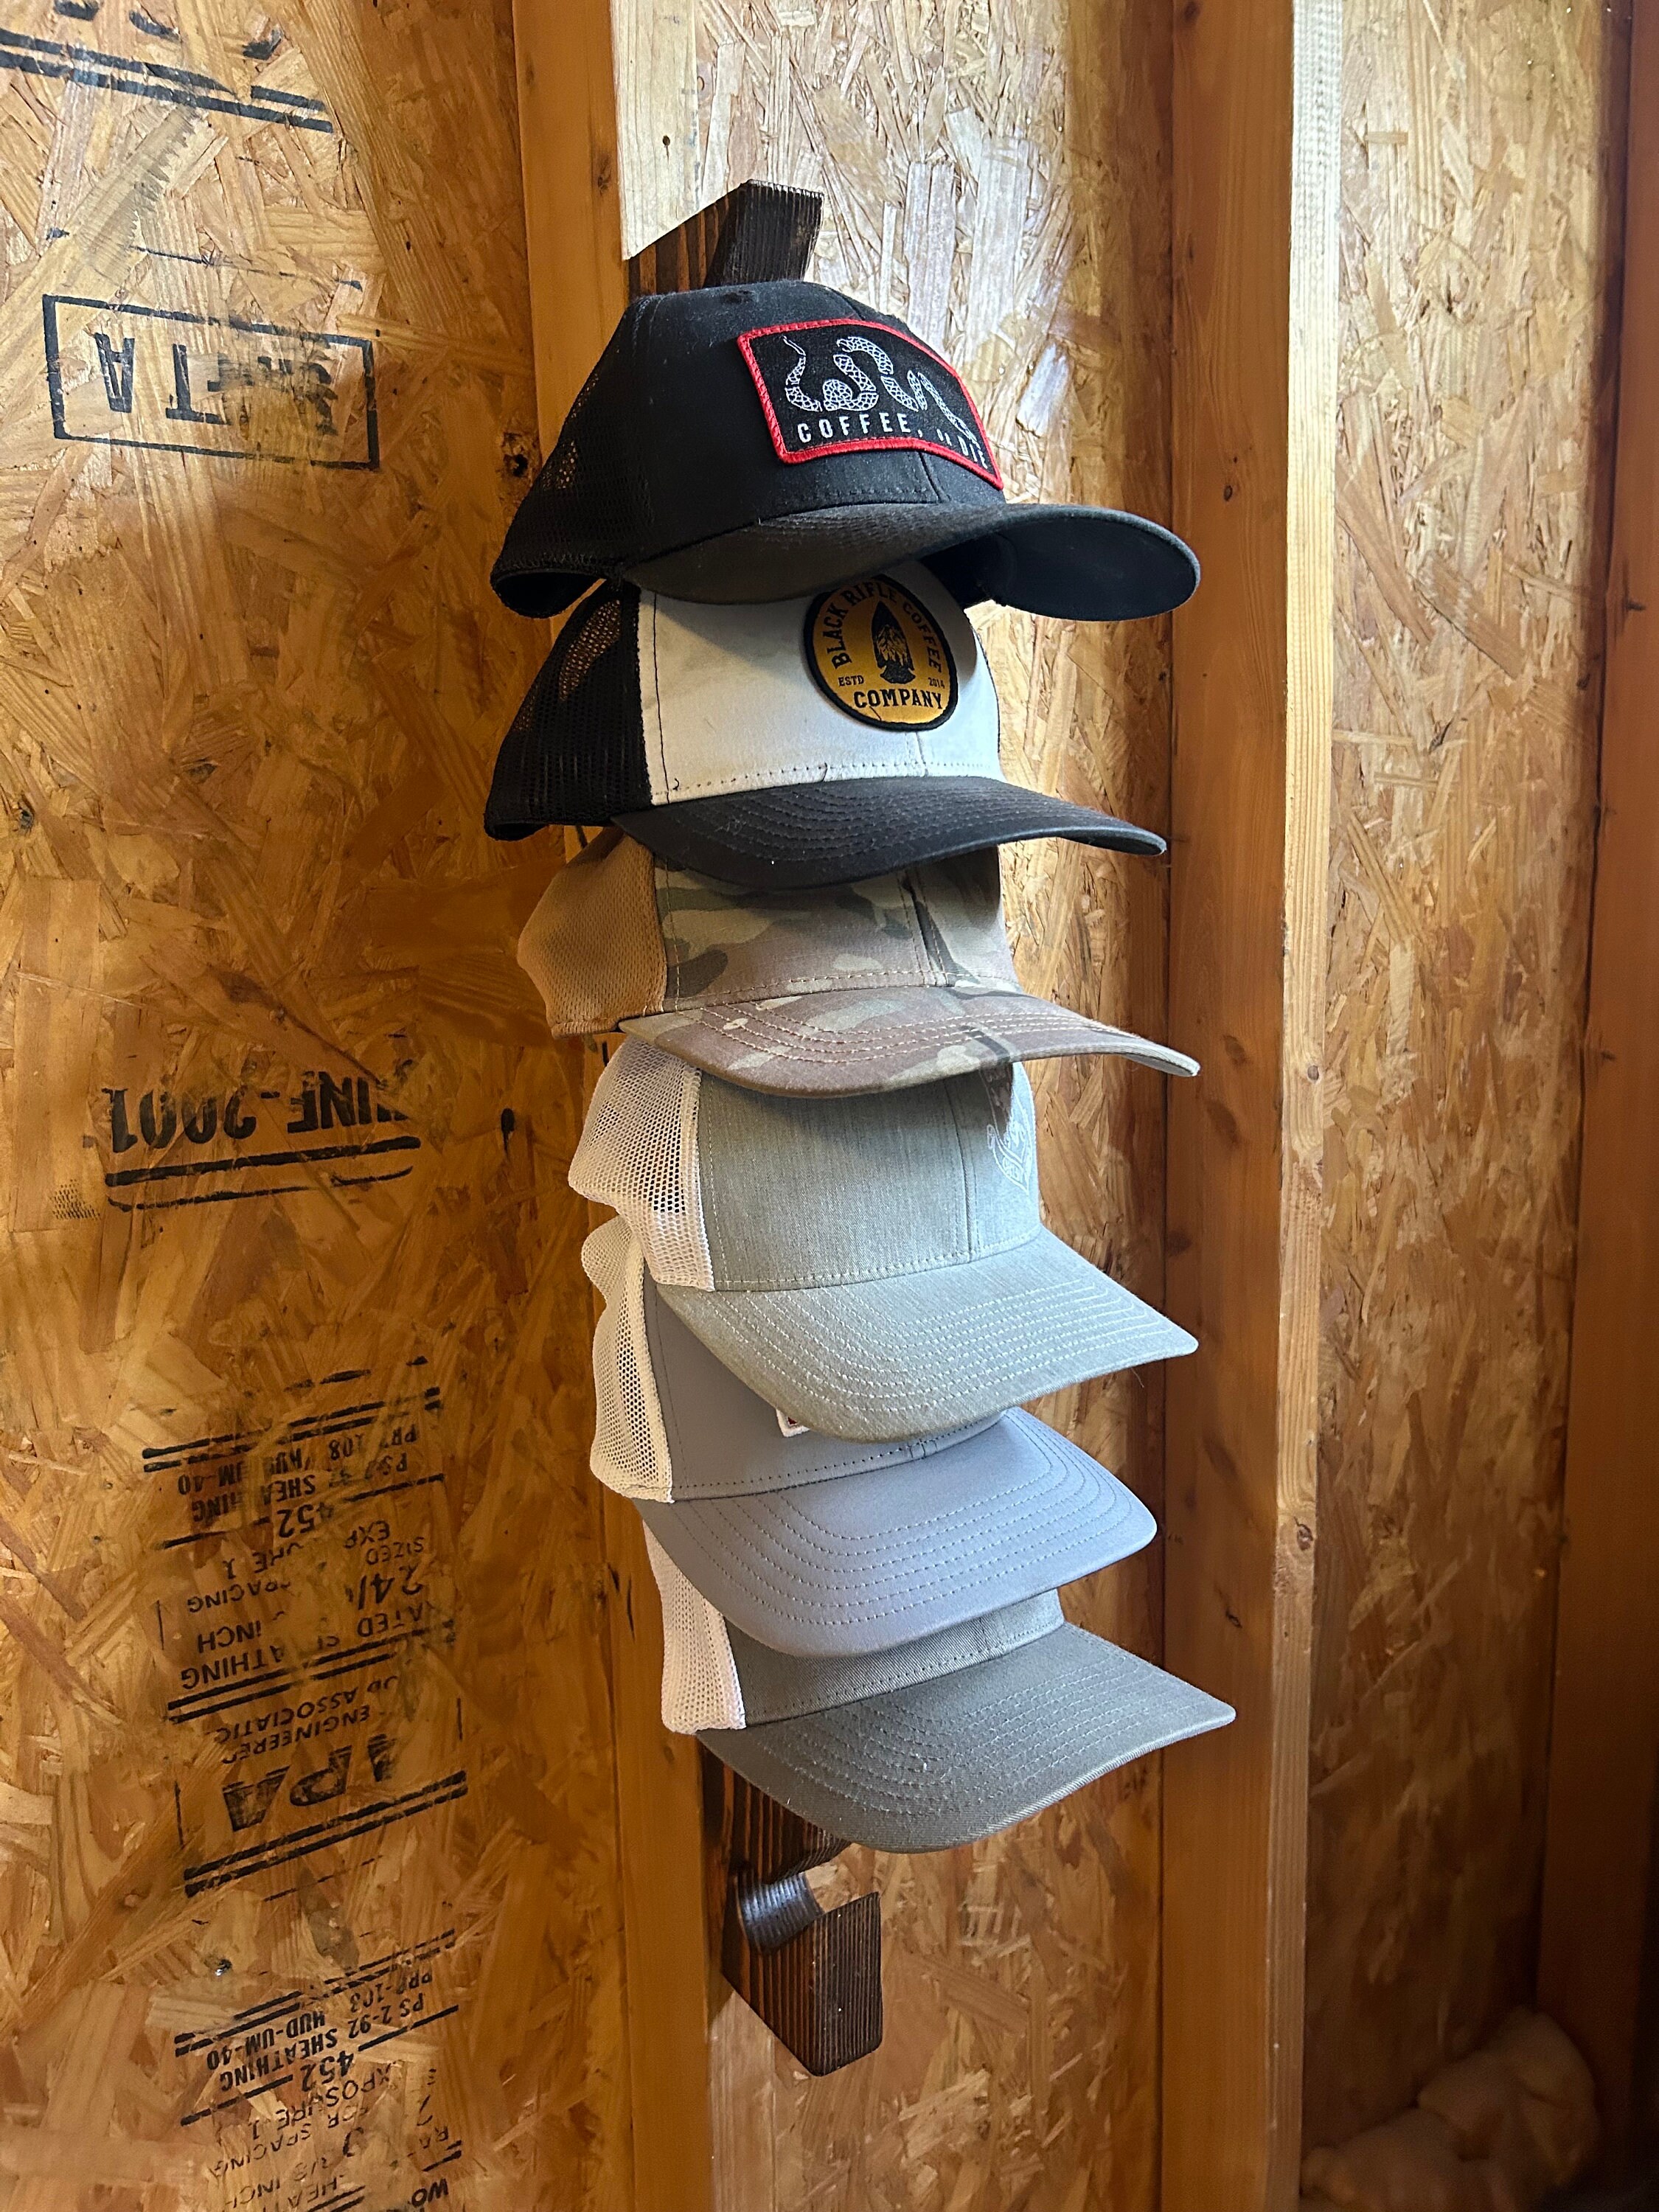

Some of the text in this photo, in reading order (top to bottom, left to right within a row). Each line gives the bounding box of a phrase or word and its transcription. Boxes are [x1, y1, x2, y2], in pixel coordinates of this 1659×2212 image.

[822, 581, 942, 673] BLACK RIFLE COFFEE
[838, 675, 945, 689] ESTD 2014
[853, 688, 943, 709] COMPANY
[220, 2028, 338, 2093] SHEATHING
[300, 2050, 354, 2093] 452
